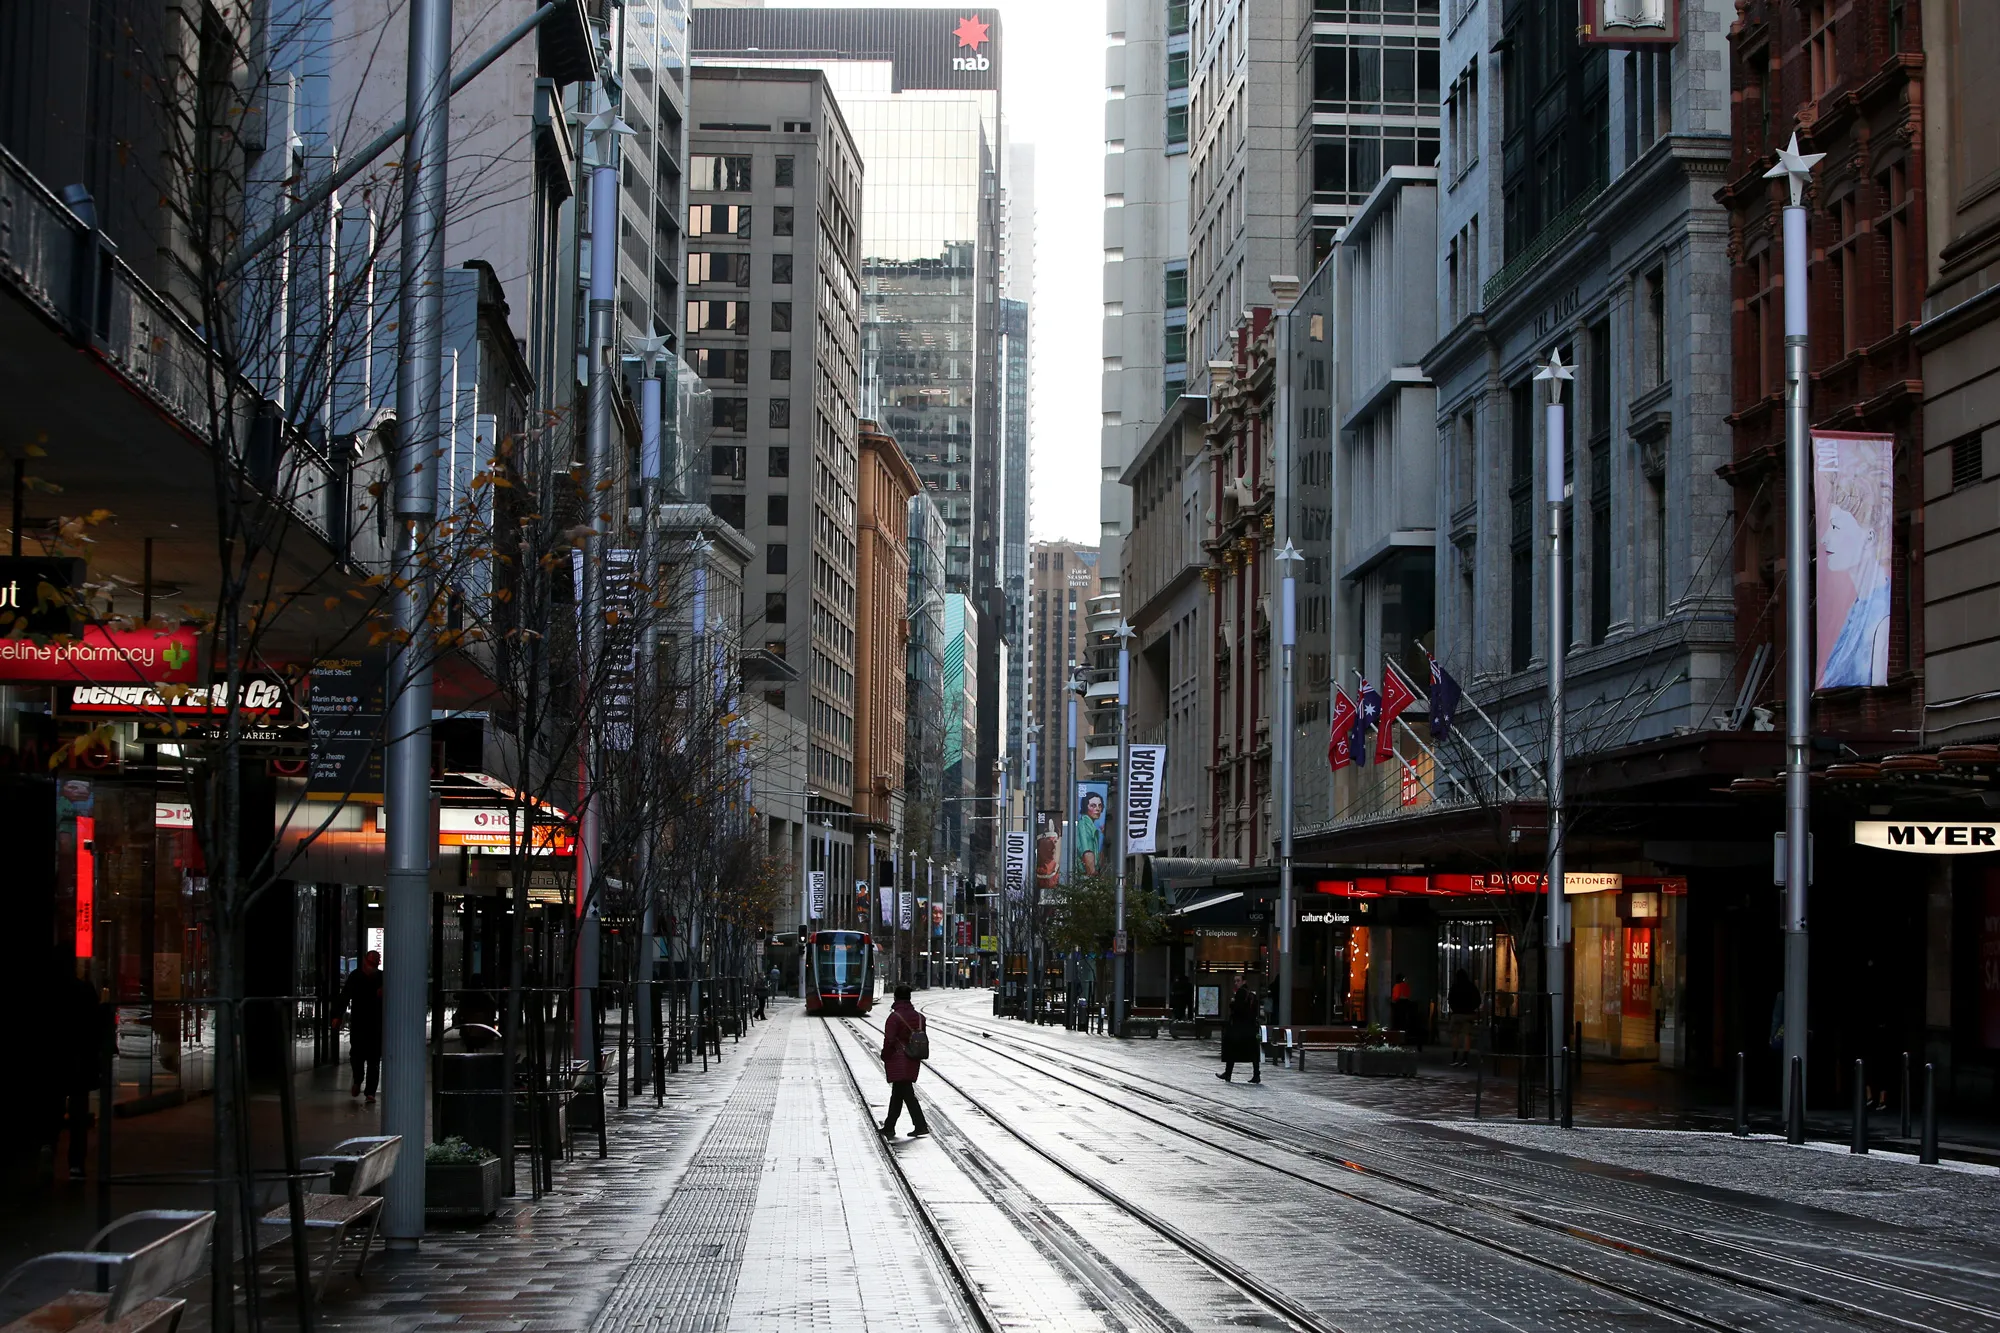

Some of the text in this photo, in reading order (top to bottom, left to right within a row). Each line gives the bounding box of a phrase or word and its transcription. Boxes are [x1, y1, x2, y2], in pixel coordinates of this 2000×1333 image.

[952, 54, 990, 72] nab
[0, 642, 154, 667] eline pharmacy
[72, 686, 168, 705] Genera
[246, 680, 282, 707] Co.
[331, 695, 345, 703] Place
[311, 704, 335, 712] Wynyard
[1887, 825, 1996, 845] MYER
[1491, 874, 1549, 886] DYMOCS
[1564, 877, 1619, 885] TATIONERY
[812, 872, 824, 913] ARCHIBALD
[1301, 911, 1350, 924] culture kings
[1204, 930, 1238, 938] Telephone
[1632, 942, 1649, 958] SALE
[1632, 963, 1649, 979] SALE
[1632, 984, 1649, 1000] SALE
